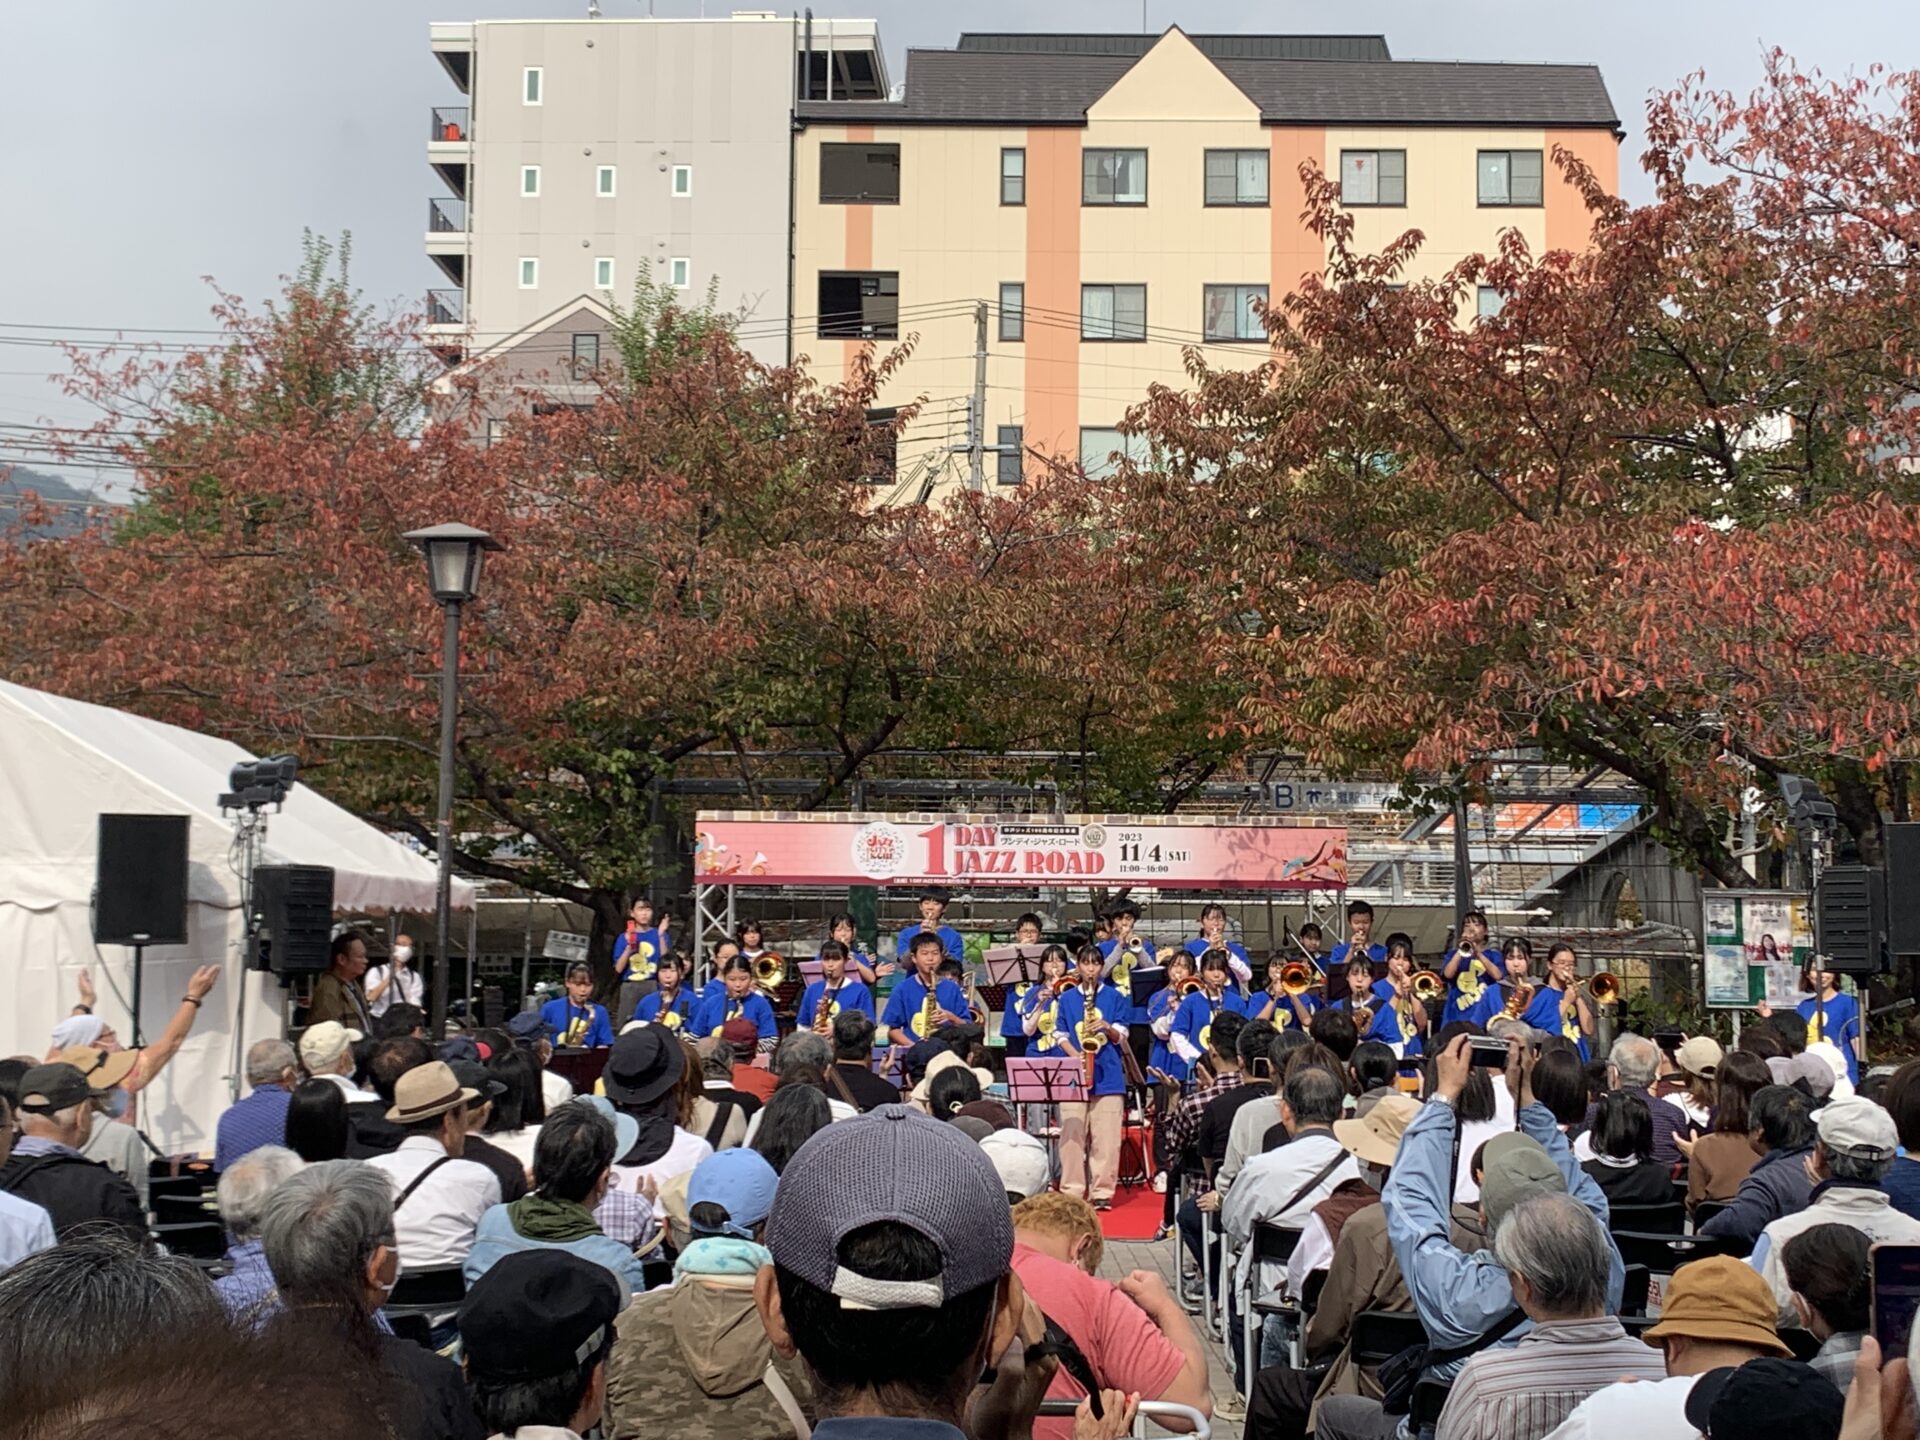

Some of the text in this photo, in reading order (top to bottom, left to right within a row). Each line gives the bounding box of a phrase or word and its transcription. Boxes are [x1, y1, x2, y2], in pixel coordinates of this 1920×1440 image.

[1275, 784, 1294, 809] B
[917, 823, 998, 875] 1 DAY
[1118, 833, 1142, 841] 2023
[952, 850, 1105, 876] JAZZ ROAD
[1119, 843, 1161, 862] 11/4
